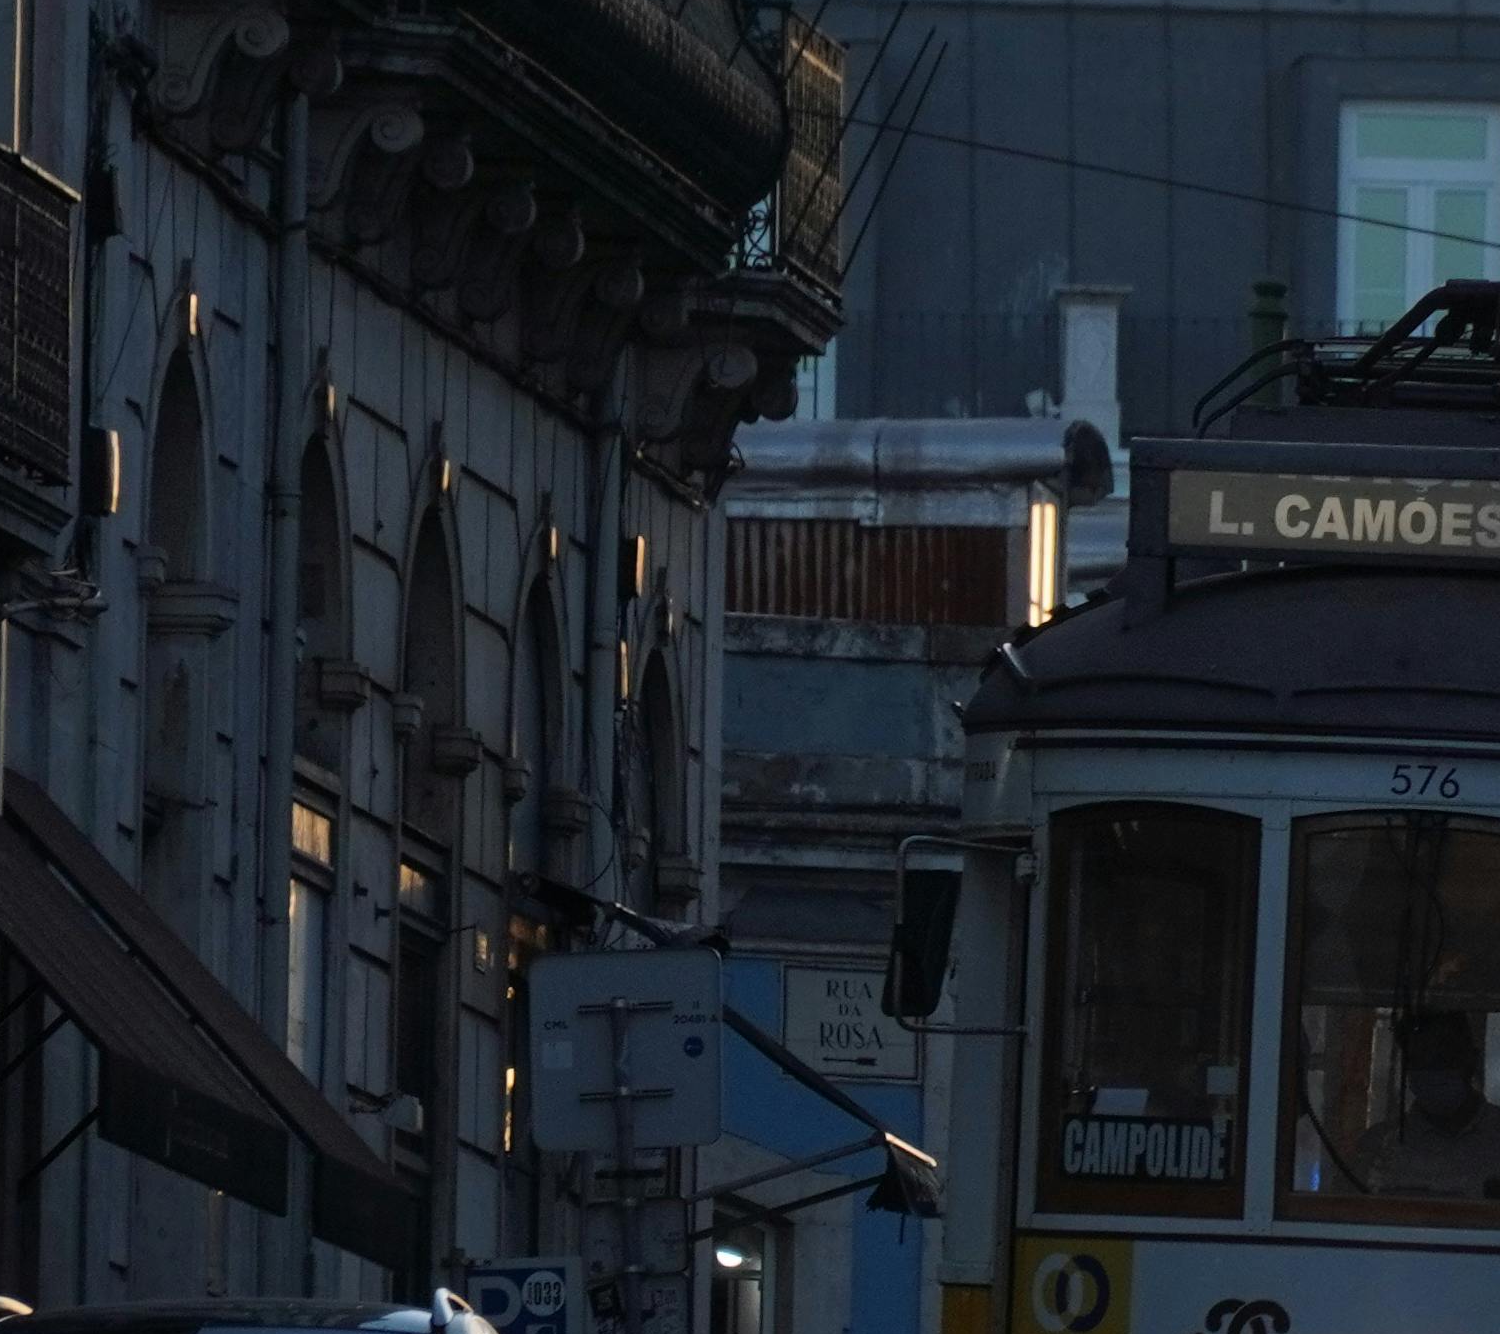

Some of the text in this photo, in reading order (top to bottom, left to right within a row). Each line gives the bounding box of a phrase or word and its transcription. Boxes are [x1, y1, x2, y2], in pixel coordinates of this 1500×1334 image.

[1209, 490, 1254, 536] L.
[1391, 765, 1459, 799] 576
[826, 979, 872, 999] RUA
[839, 1003, 861, 1016] DA
[543, 1020, 569, 1030] CML
[819, 1022, 882, 1049] ROSA
[1063, 1118, 1228, 1181] CAMPOLIDE
